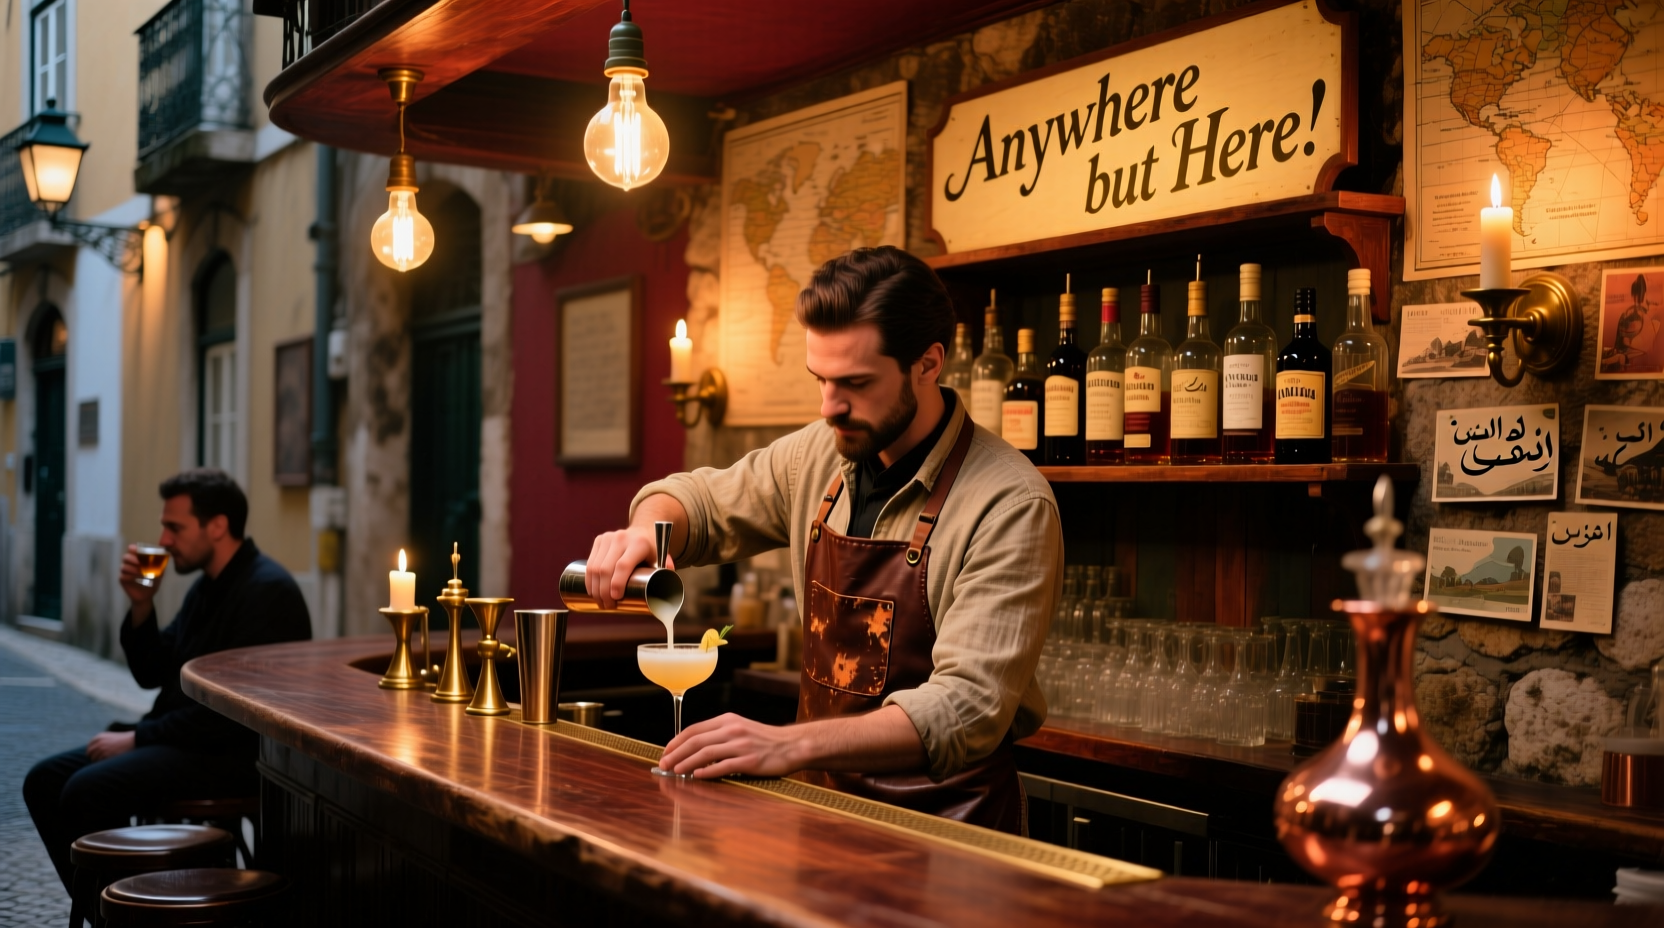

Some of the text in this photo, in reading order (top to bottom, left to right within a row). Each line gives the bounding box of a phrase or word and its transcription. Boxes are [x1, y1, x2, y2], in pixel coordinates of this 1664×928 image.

[944, 64, 1200, 202] Anywhere
[1085, 78, 1327, 214] but Here!
